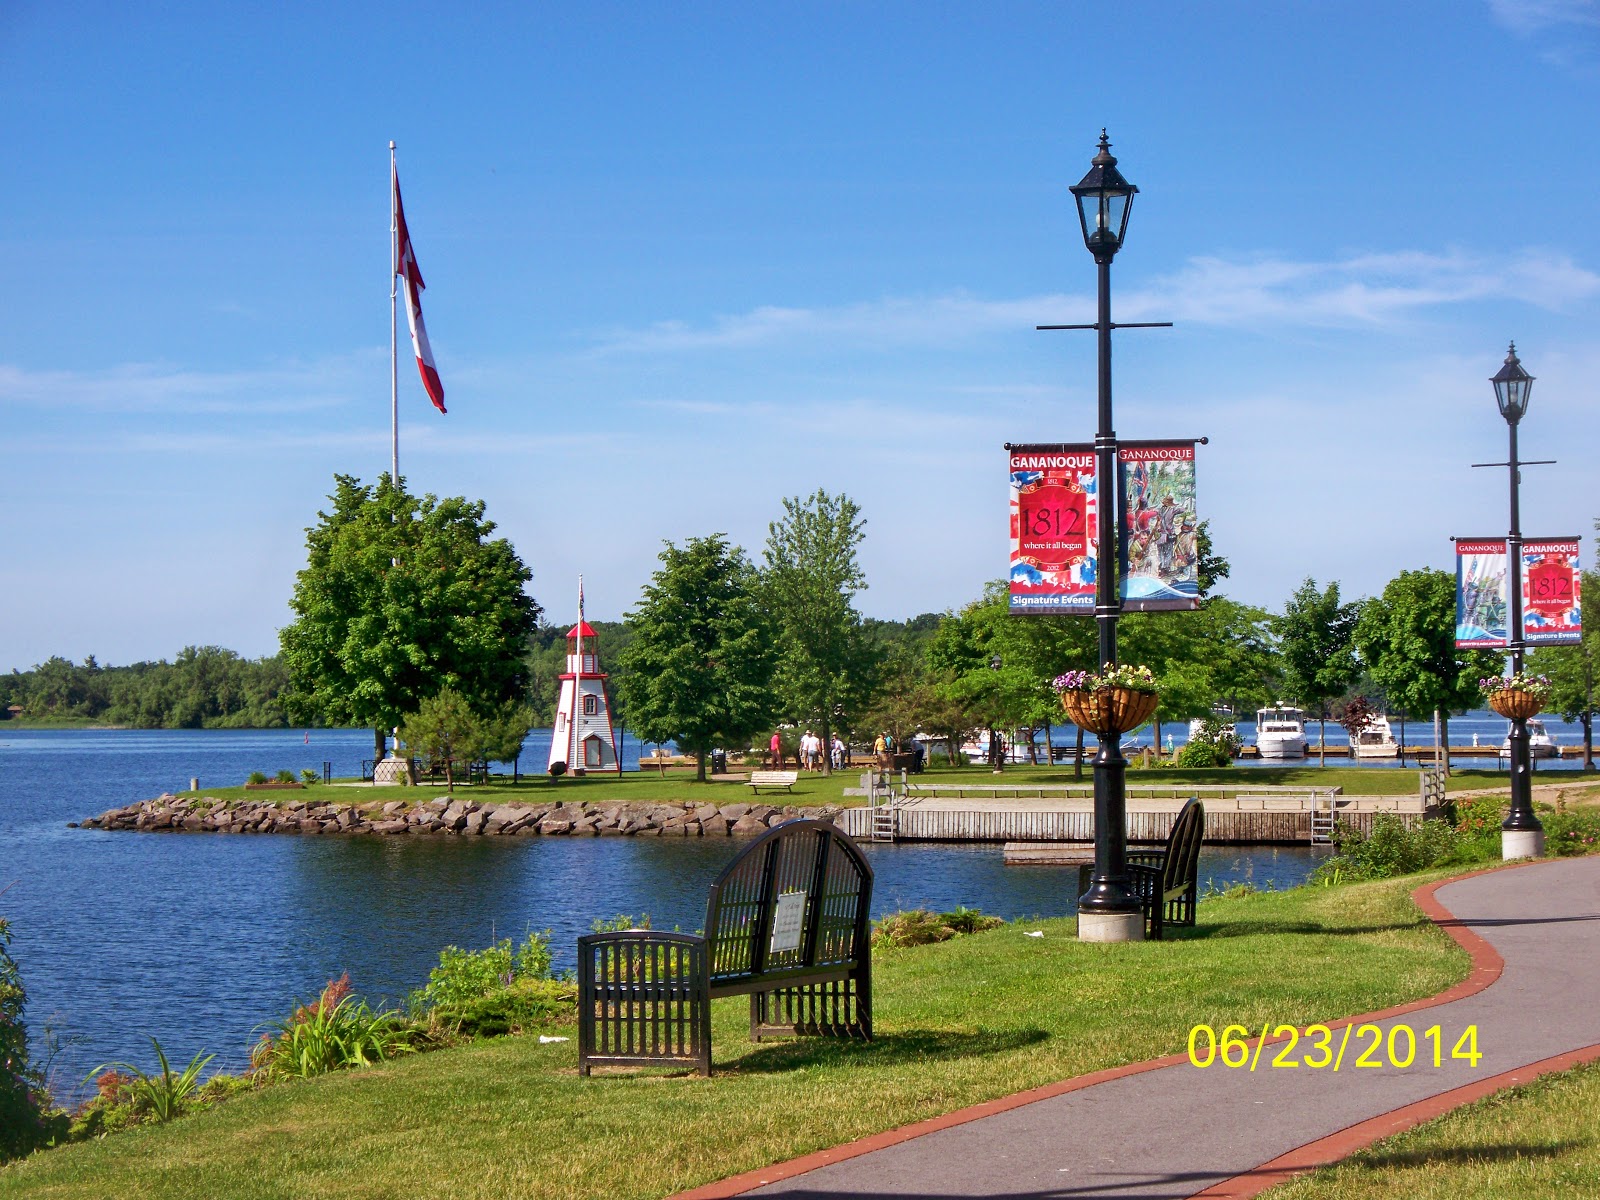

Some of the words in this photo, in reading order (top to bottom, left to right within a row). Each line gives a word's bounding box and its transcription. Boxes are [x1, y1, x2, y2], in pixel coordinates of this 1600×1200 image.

[1118, 449, 1192, 462] GANANOQUE
[1010, 456, 1093, 469] GANANOQUE
[1022, 507, 1085, 536] 1812
[1024, 541, 1045, 549] where
[1052, 541, 1060, 549] all
[1061, 541, 1082, 551] began
[1458, 545, 1505, 554] GANANOQUE
[1523, 544, 1578, 554] GANANOQUE
[1531, 577, 1573, 596] 1812
[1012, 595, 1060, 606] Signature
[1061, 595, 1094, 605] Events
[1526, 632, 1558, 641] Signature
